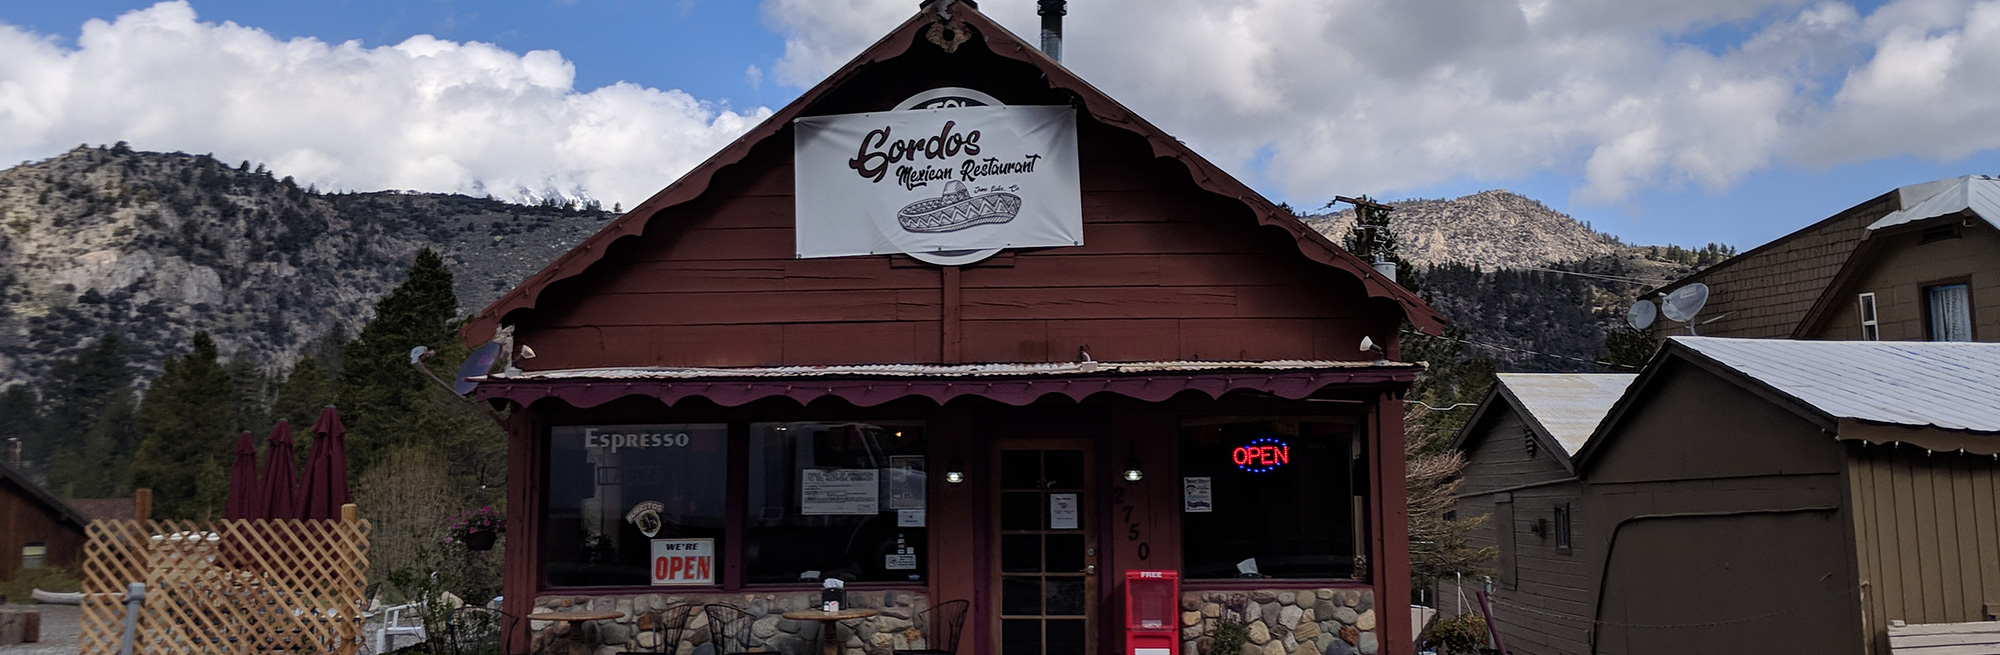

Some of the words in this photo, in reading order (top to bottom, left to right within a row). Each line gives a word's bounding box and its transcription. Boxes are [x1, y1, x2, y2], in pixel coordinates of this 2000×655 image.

[848, 120, 981, 183] Gordos
[895, 164, 953, 191] Mexican
[960, 153, 1042, 182] Restaurant
[1232, 445, 1289, 465] OPEN
[665, 542, 699, 551] WE'RE
[655, 555, 711, 581] OPEN
